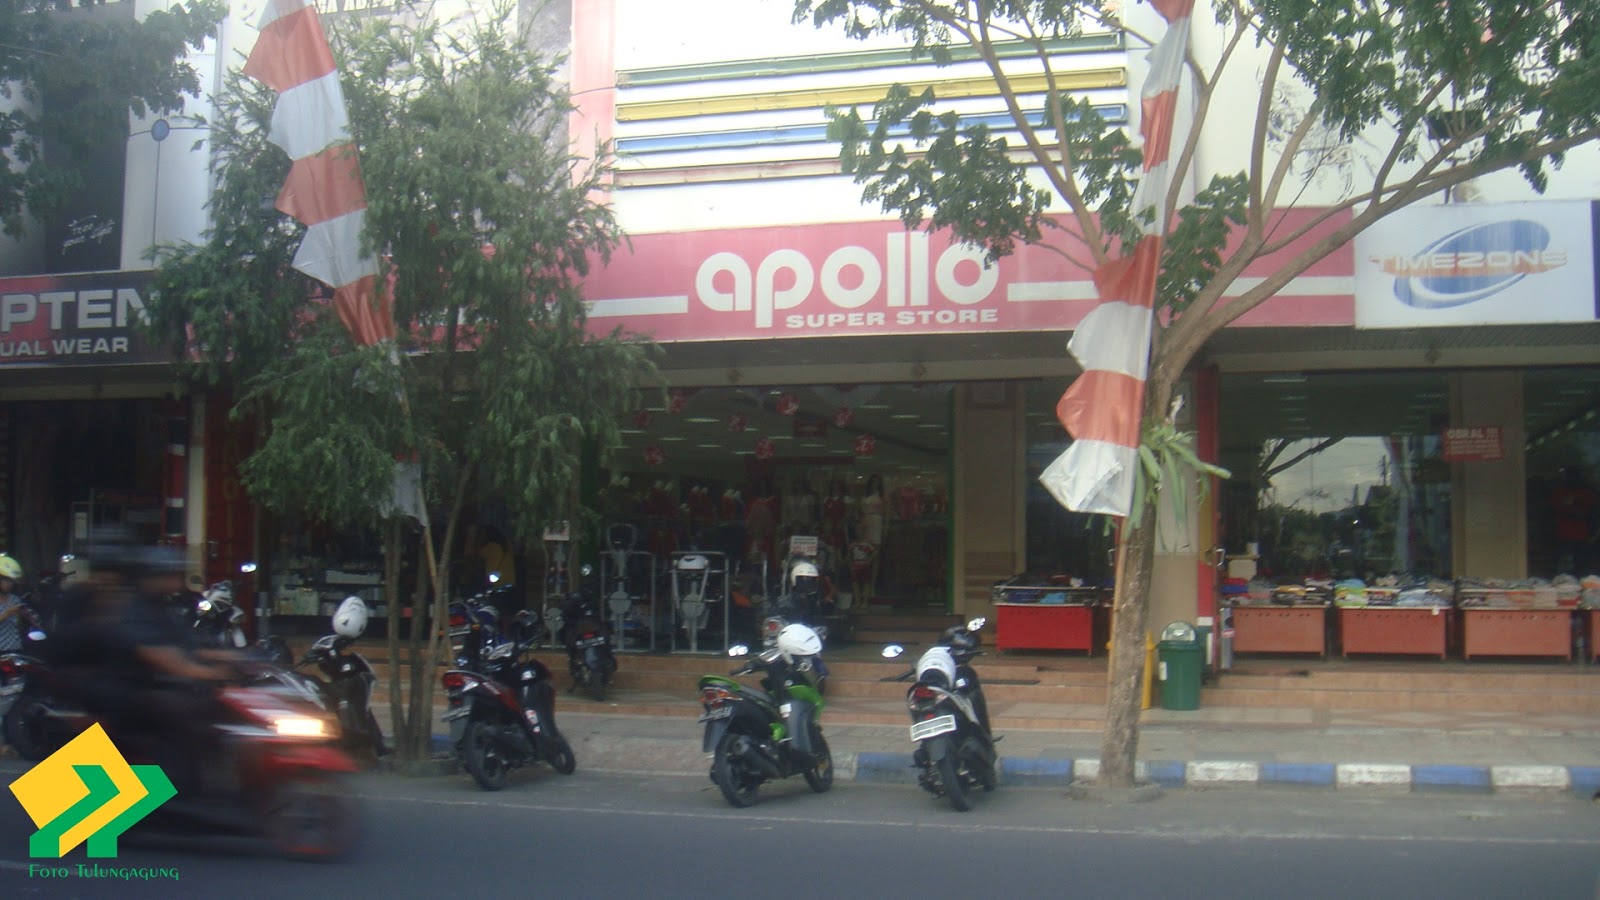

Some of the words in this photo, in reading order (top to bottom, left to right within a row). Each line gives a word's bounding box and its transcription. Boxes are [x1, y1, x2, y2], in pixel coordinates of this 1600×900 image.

[1368, 250, 1568, 274] TIMEZONE
[695, 231, 999, 328] apollo
[785, 312, 886, 328] SUPER
[895, 309, 999, 325] STORE
[52, 336, 129, 355] WEAR
